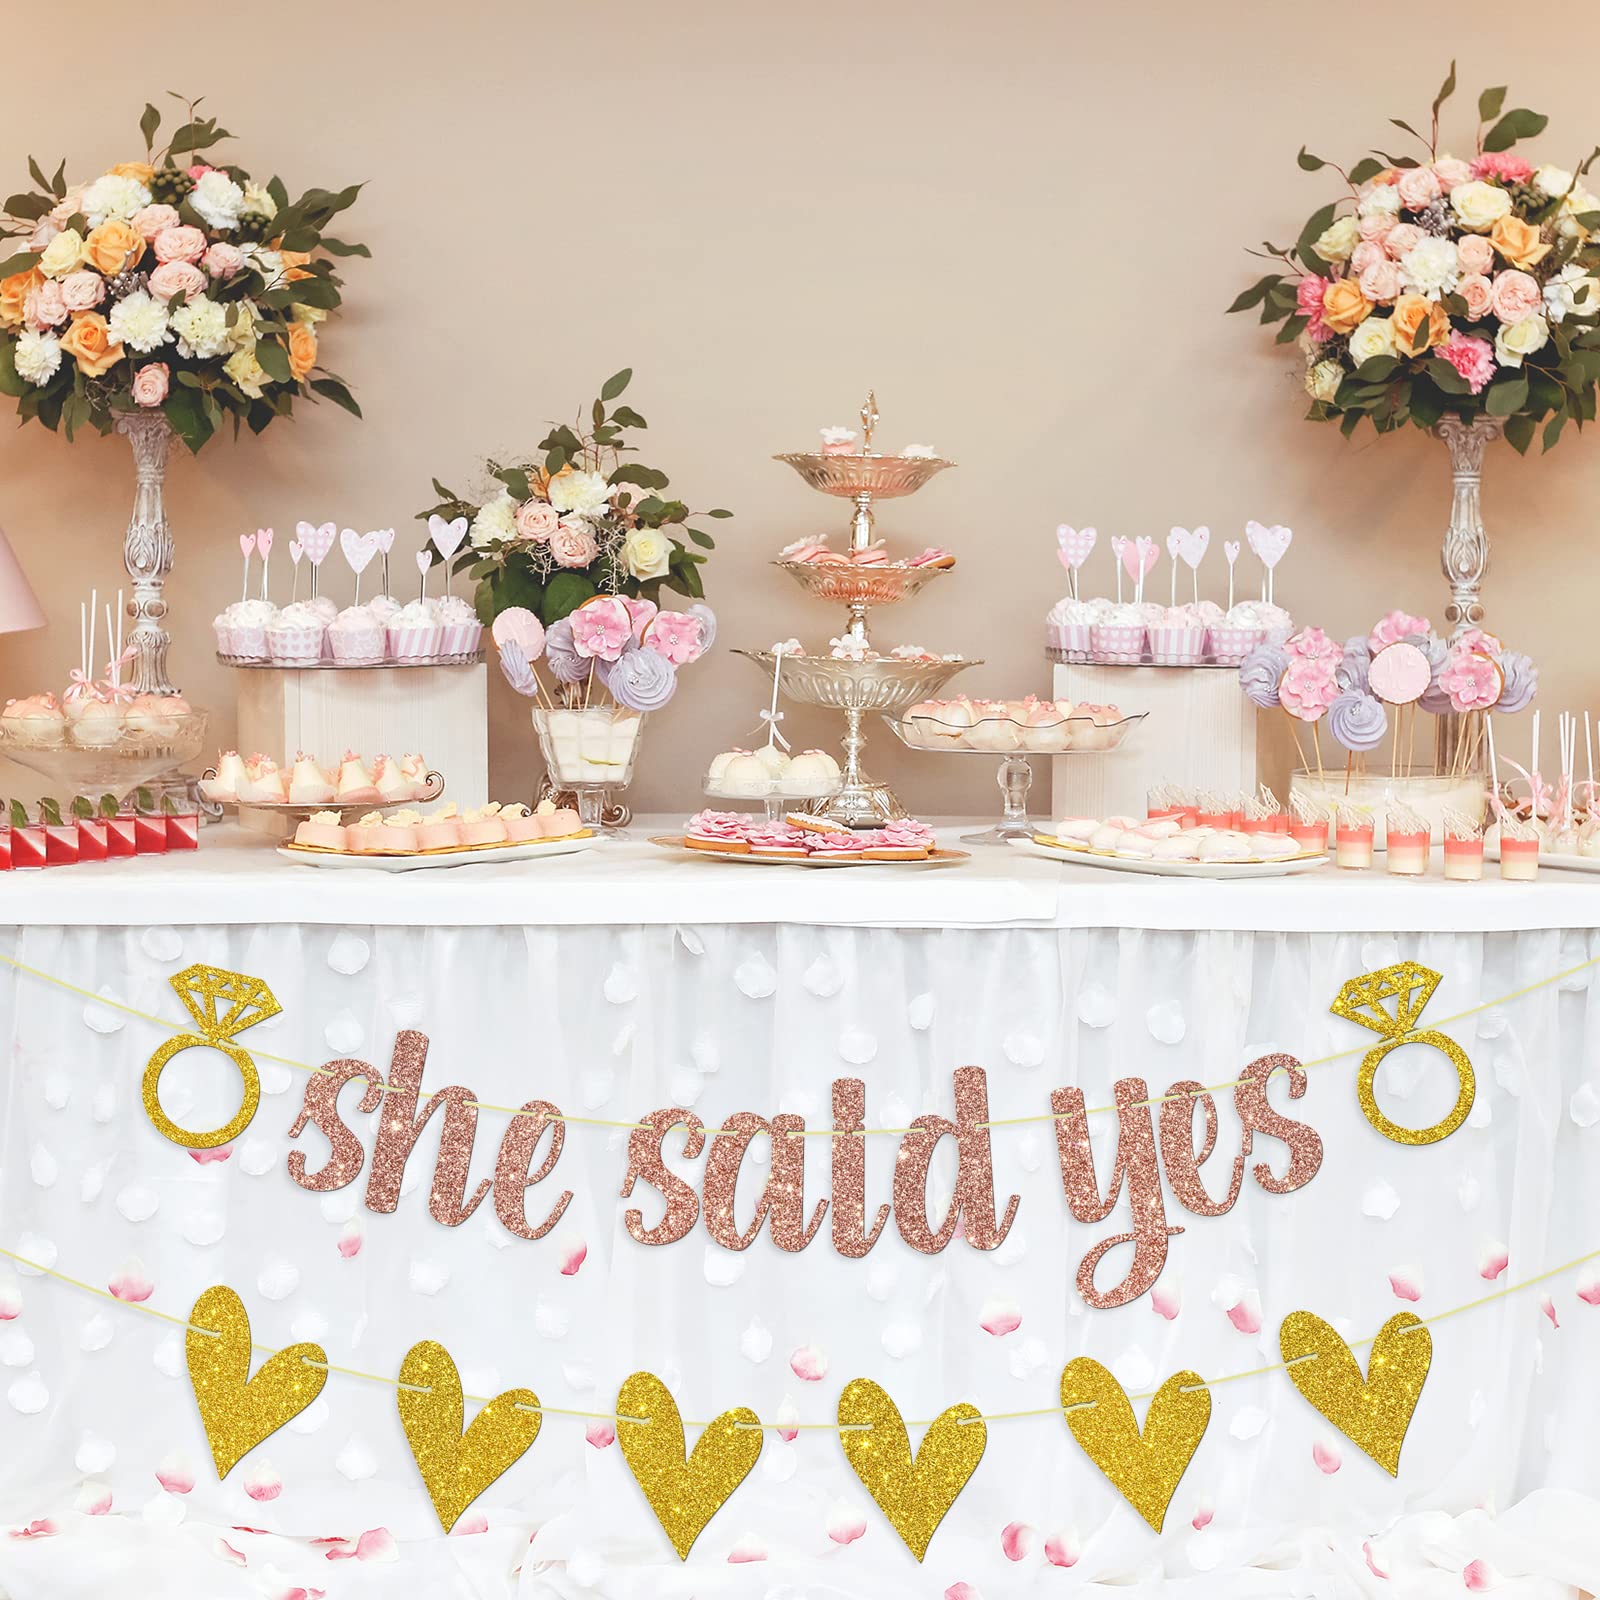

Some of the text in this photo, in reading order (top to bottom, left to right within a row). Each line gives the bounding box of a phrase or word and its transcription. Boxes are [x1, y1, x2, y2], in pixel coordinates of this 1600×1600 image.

[288, 1030, 1324, 1309] she said yes
